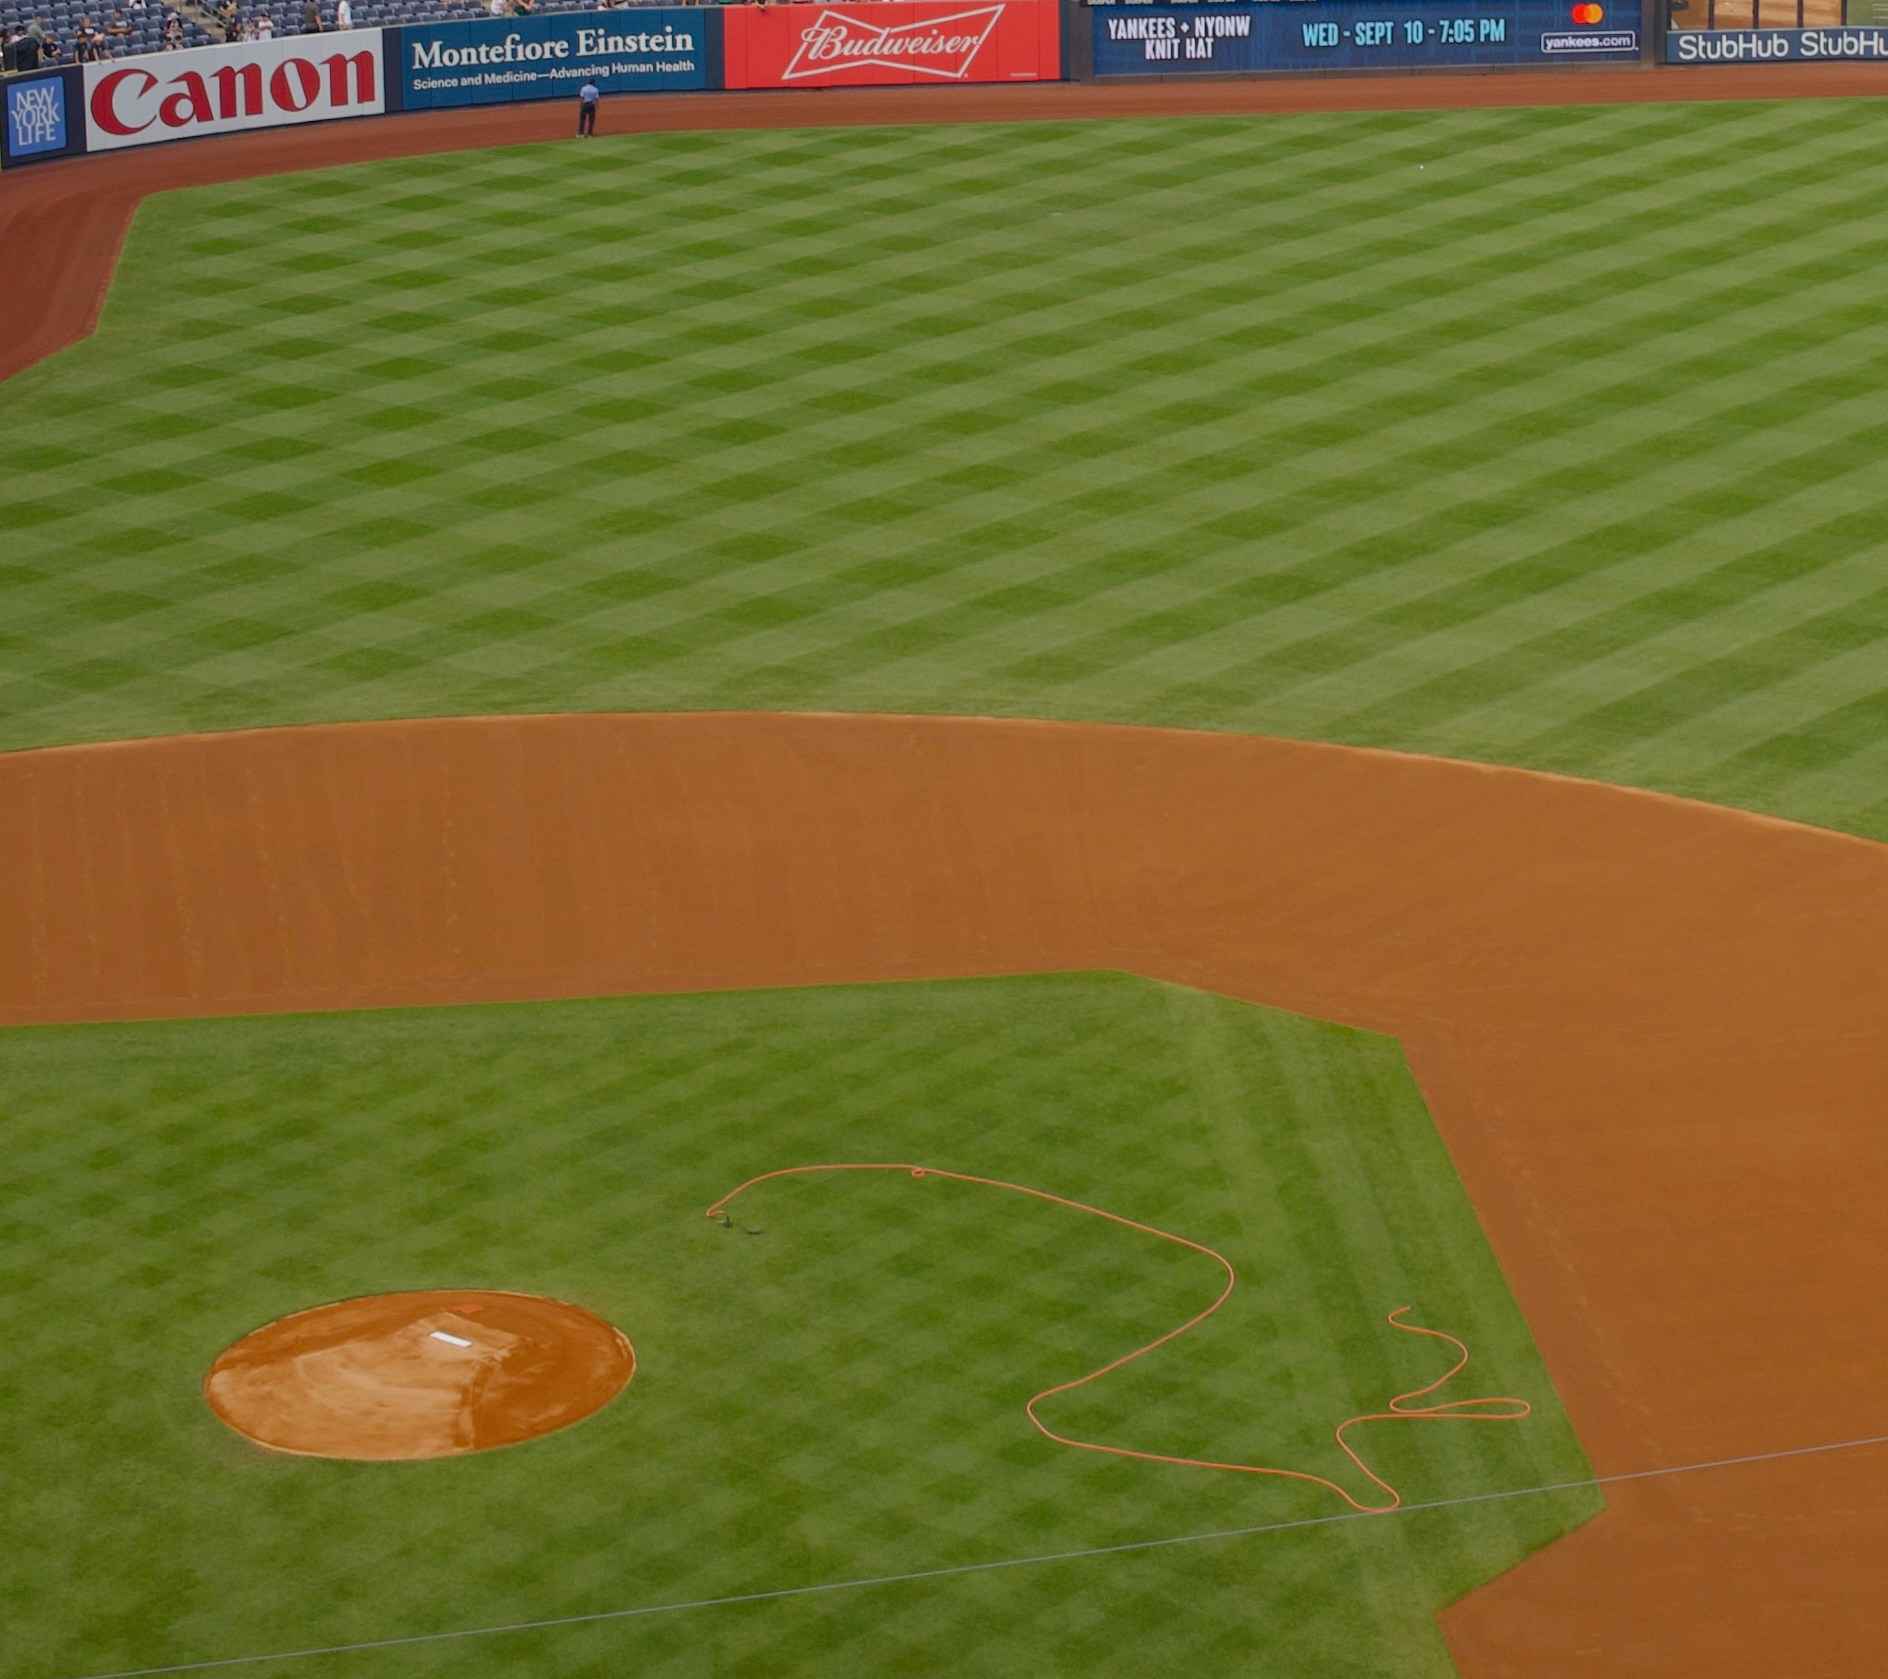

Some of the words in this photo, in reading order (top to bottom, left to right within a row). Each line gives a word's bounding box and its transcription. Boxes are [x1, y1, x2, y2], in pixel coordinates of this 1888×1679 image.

[1108, 17, 1175, 39] YANKEES
[1195, 15, 1250, 37] NYONW
[1303, 23, 1338, 47] WED
[1355, 21, 1394, 45] SEPT
[1404, 20, 1423, 43] 10
[1440, 20, 1475, 43] 7:05
[1479, 18, 1505, 42] PM
[412, 34, 568, 69] Montefiore
[576, 26, 694, 56] Einstein
[802, 26, 981, 60] Budweiser
[1145, 39, 1179, 60] KNIT
[1185, 38, 1214, 58] HAT
[1546, 34, 1631, 50] yankees.com
[1679, 33, 1788, 60] StubHub
[413, 78, 458, 90] Science
[461, 74, 482, 86] and
[612, 62, 653, 72] Human
[656, 60, 694, 71] Health
[16, 87, 54, 108] NEW
[91, 51, 374, 135] Canon
[12, 102, 59, 128] YORK
[18, 123, 55, 146] LIFE
